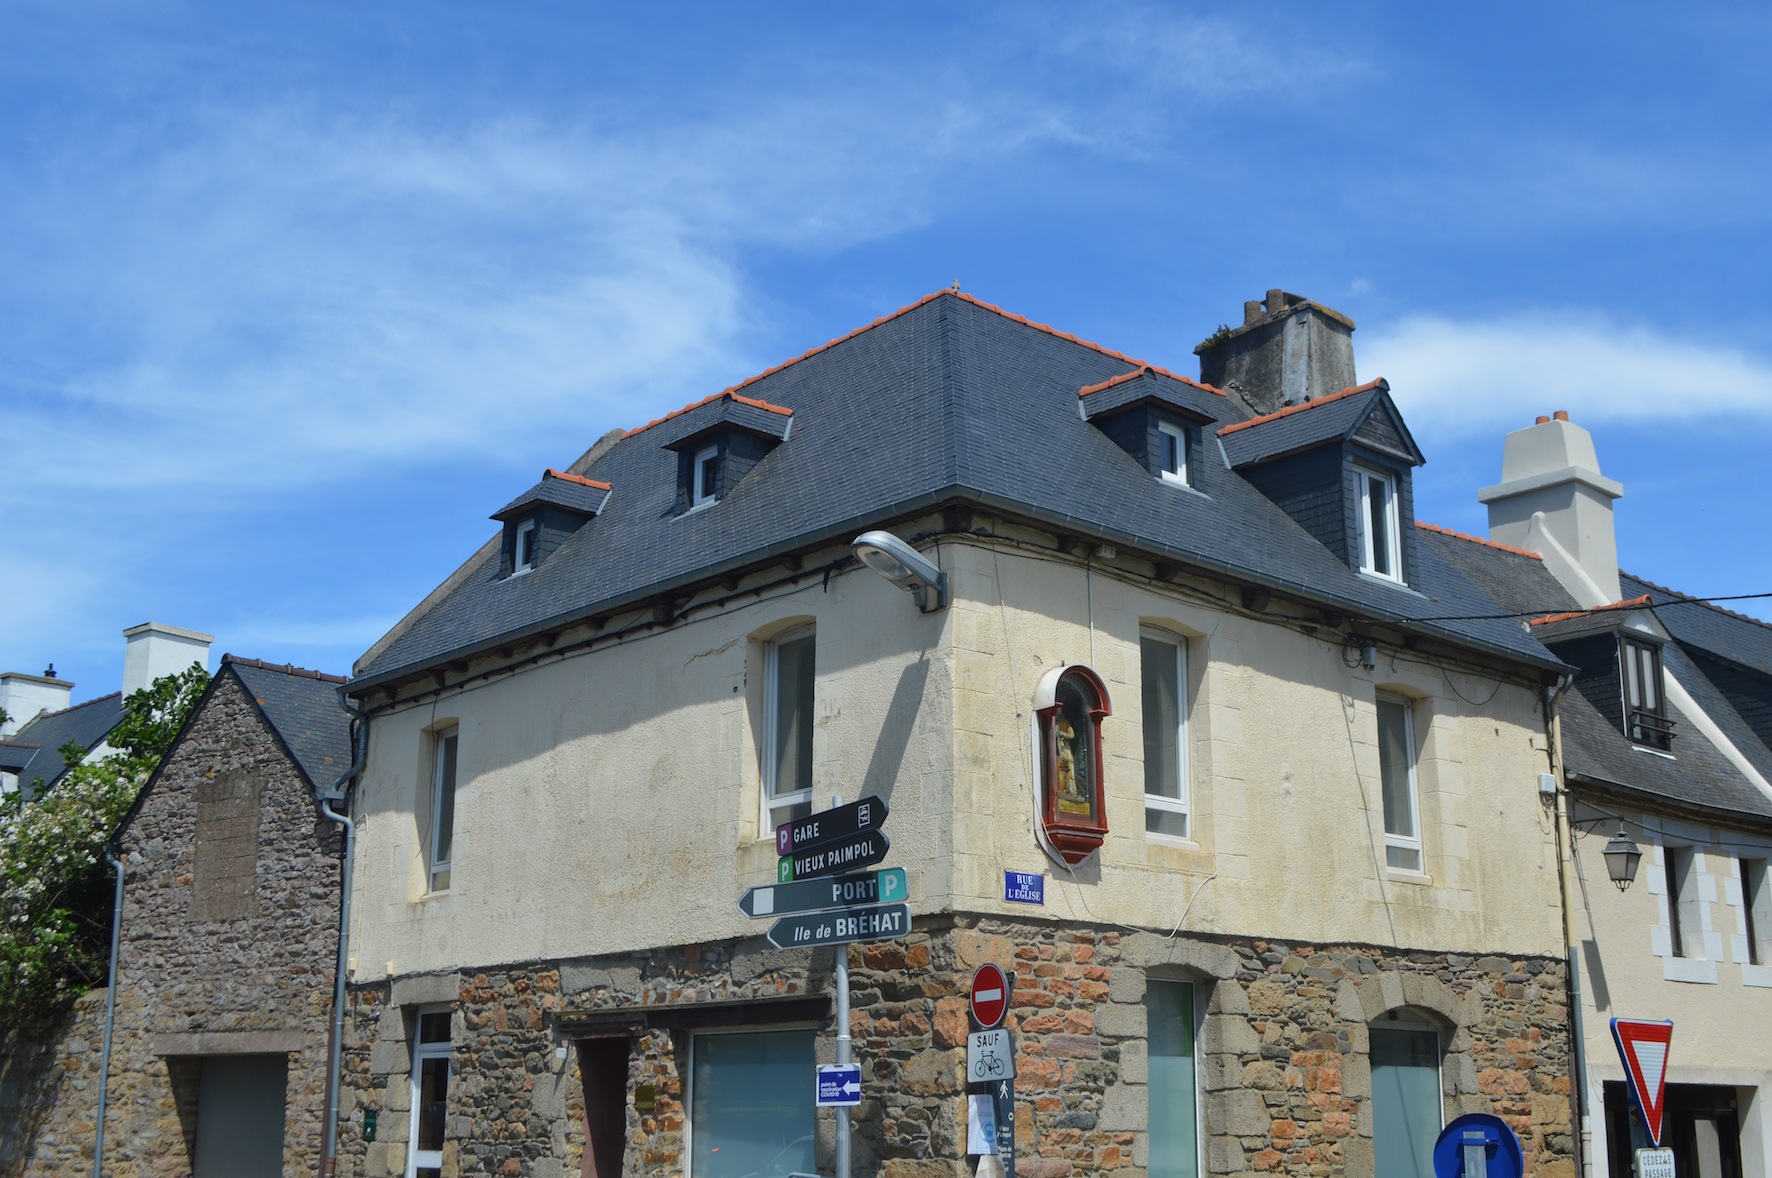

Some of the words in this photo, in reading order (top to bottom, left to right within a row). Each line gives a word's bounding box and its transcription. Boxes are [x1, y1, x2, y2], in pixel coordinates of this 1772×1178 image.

[780, 830, 788, 849] P
[793, 822, 819, 843] GARE
[781, 862, 789, 881] P
[794, 854, 825, 875] VIEUX
[828, 840, 875, 867] PAIMPOL
[832, 880, 876, 902] PORT
[884, 874, 898, 896] P
[1017, 875, 1033, 885] RUE
[794, 926, 811, 942] Ile
[816, 923, 831, 939] de
[836, 910, 902, 937] BRÉHAT
[976, 1033, 1000, 1048] SAUF
[1643, 1154, 1662, 1166] CÉDEZ
[1644, 1168, 1672, 1178] PASSAGE
